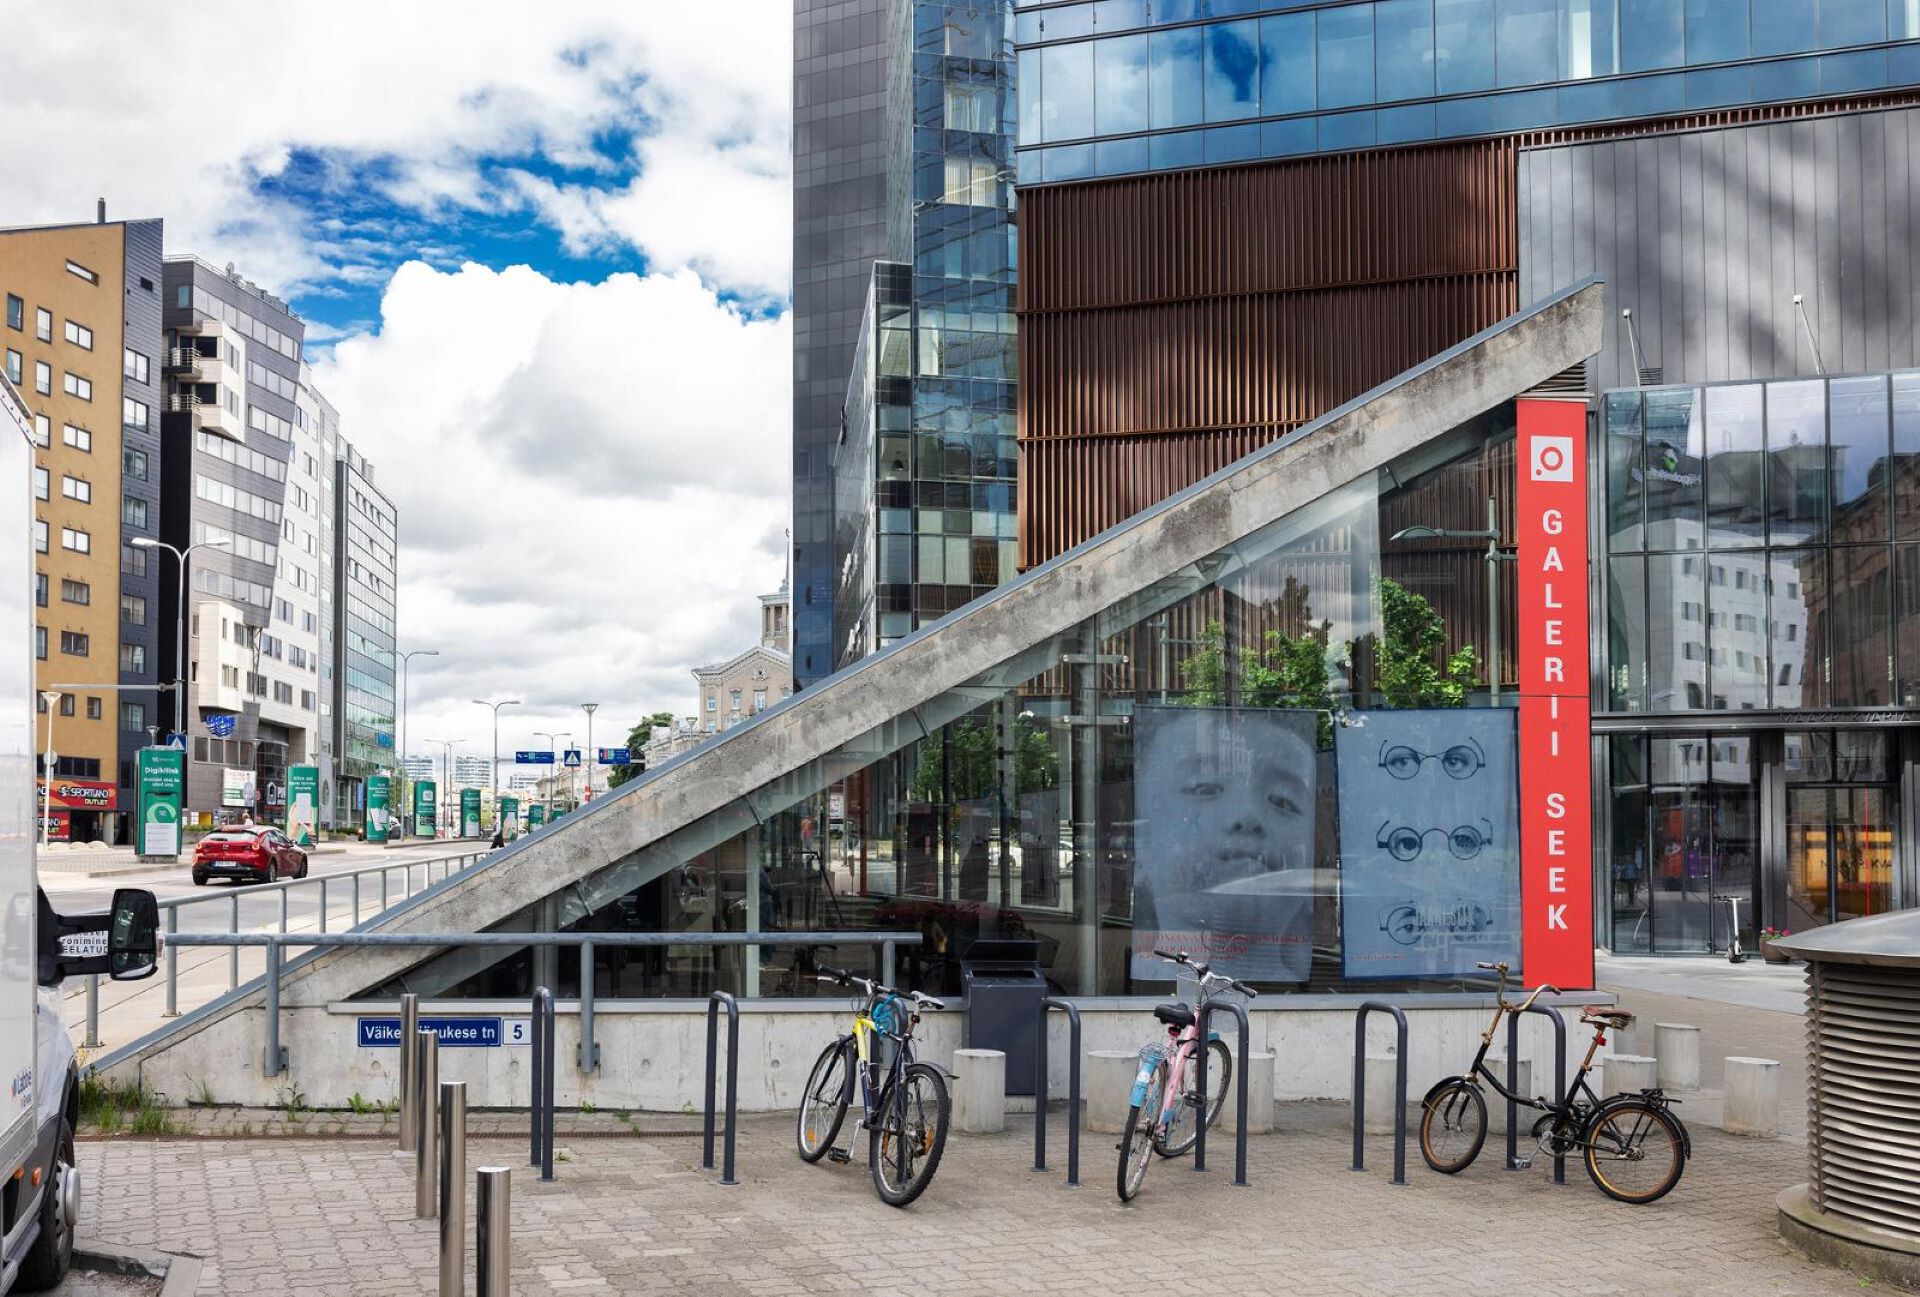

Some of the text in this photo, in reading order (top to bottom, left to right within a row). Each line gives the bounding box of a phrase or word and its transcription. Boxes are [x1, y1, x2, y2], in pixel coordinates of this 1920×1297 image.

[1542, 509, 1568, 930] GALERII SEEK
[70, 786, 109, 798] SPORTLAND
[482, 1027, 495, 1039] tn
[513, 1024, 523, 1040] 5
